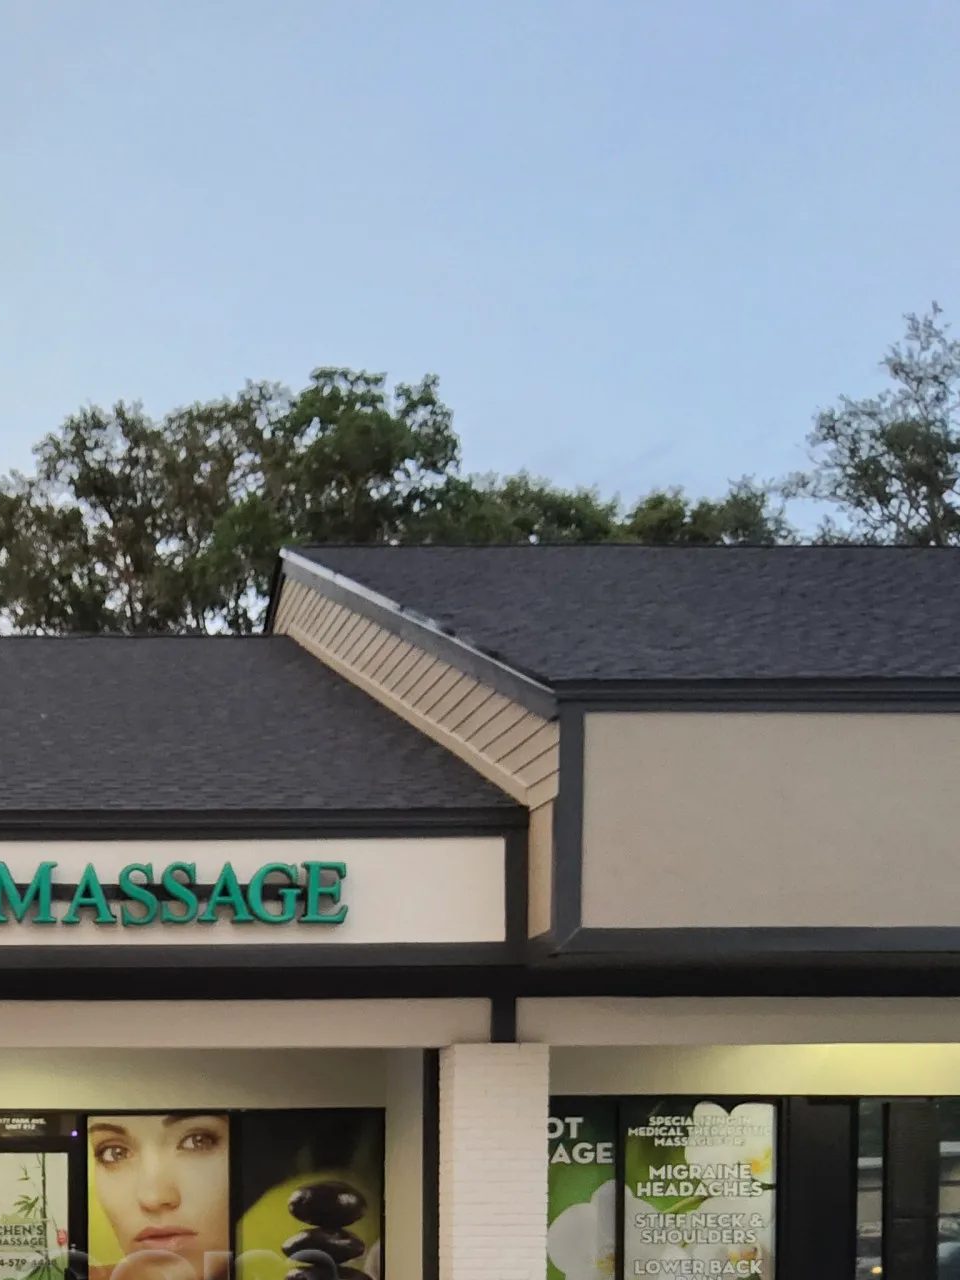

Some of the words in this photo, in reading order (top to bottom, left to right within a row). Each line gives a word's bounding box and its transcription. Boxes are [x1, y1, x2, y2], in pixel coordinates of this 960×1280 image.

[627, 1126, 685, 1137] MEDICAL
[648, 1164, 751, 1181] MIGRAINE
[636, 1181, 764, 1198] HEADACHES
[634, 1212, 688, 1229] STIFF
[691, 1212, 745, 1229] NECK
[749, 1212, 765, 1229] &
[640, 1229, 759, 1246] SHOULDERS
[633, 1259, 706, 1276] LOWER
[710, 1259, 764, 1276] BACK
